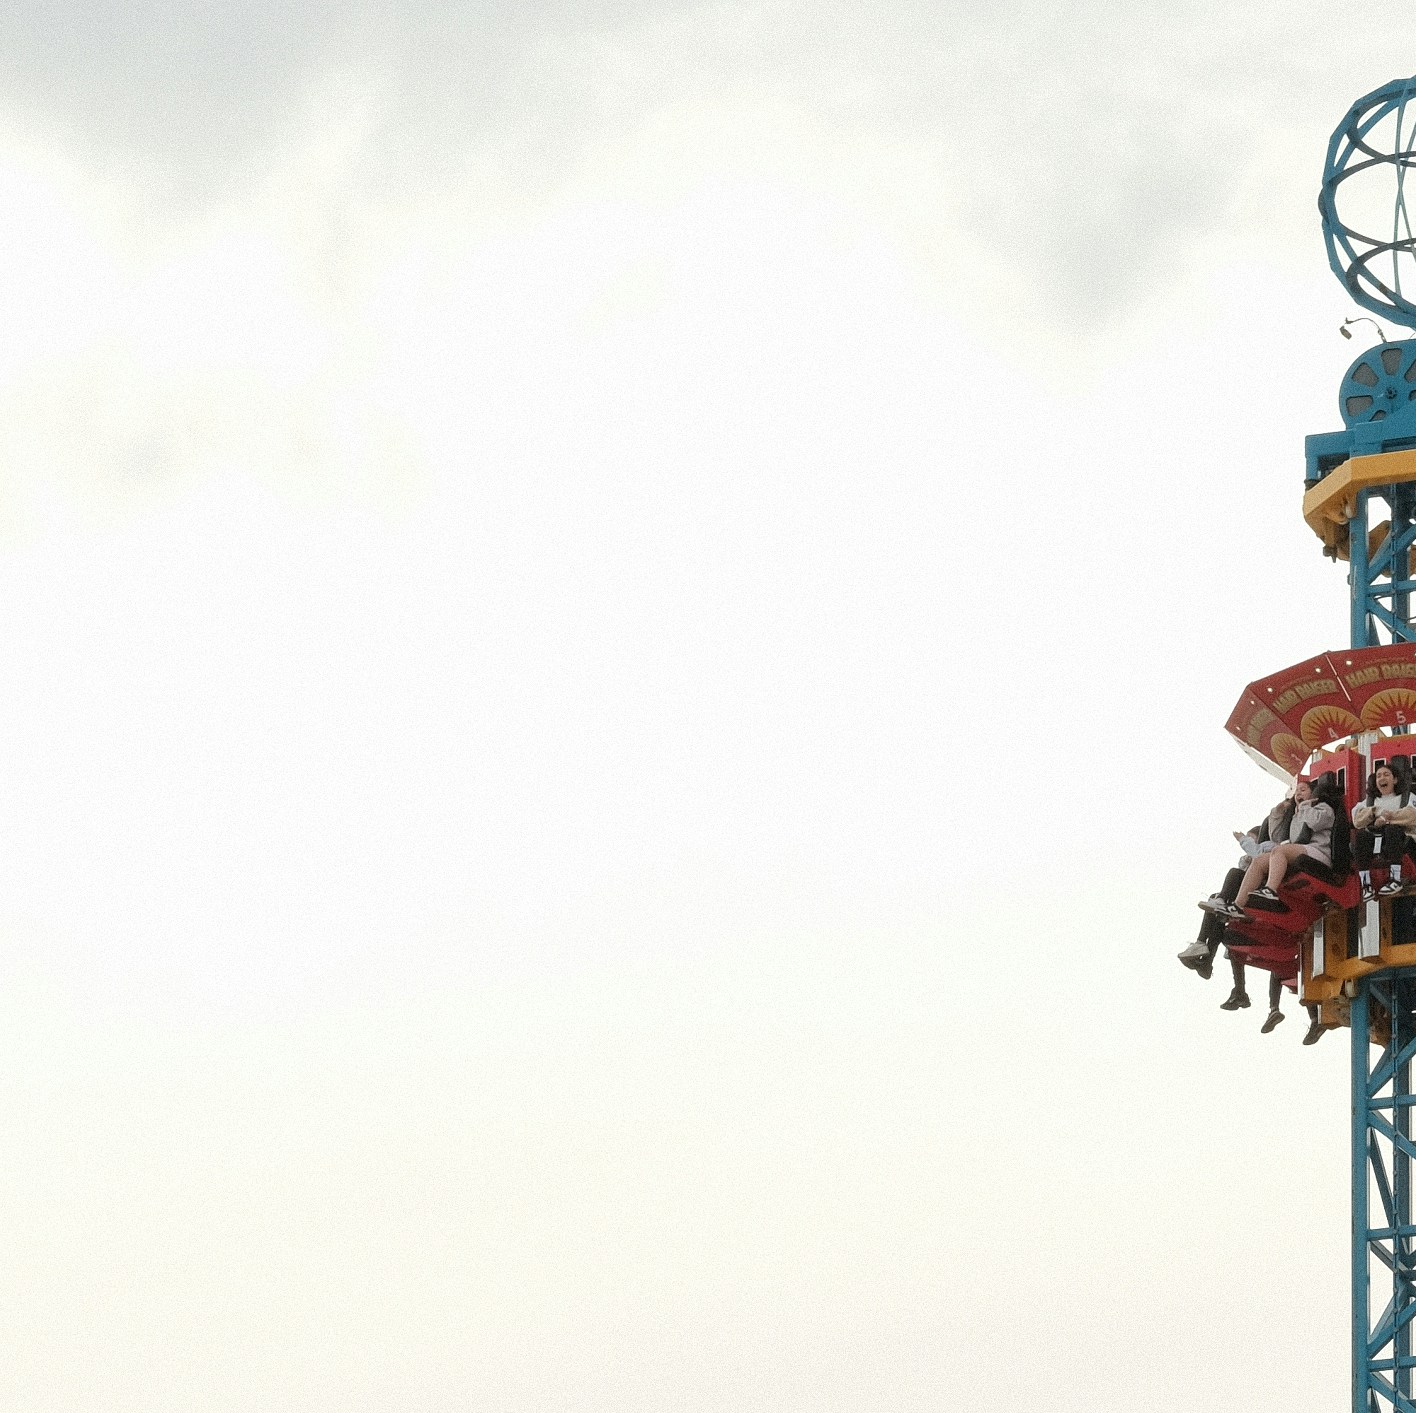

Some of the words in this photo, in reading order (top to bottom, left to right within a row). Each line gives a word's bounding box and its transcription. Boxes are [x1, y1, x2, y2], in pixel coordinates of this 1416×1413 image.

[1345, 667, 1380, 689] HAIR
[1396, 711, 1407, 724] 5
[1328, 727, 1338, 739] 4
